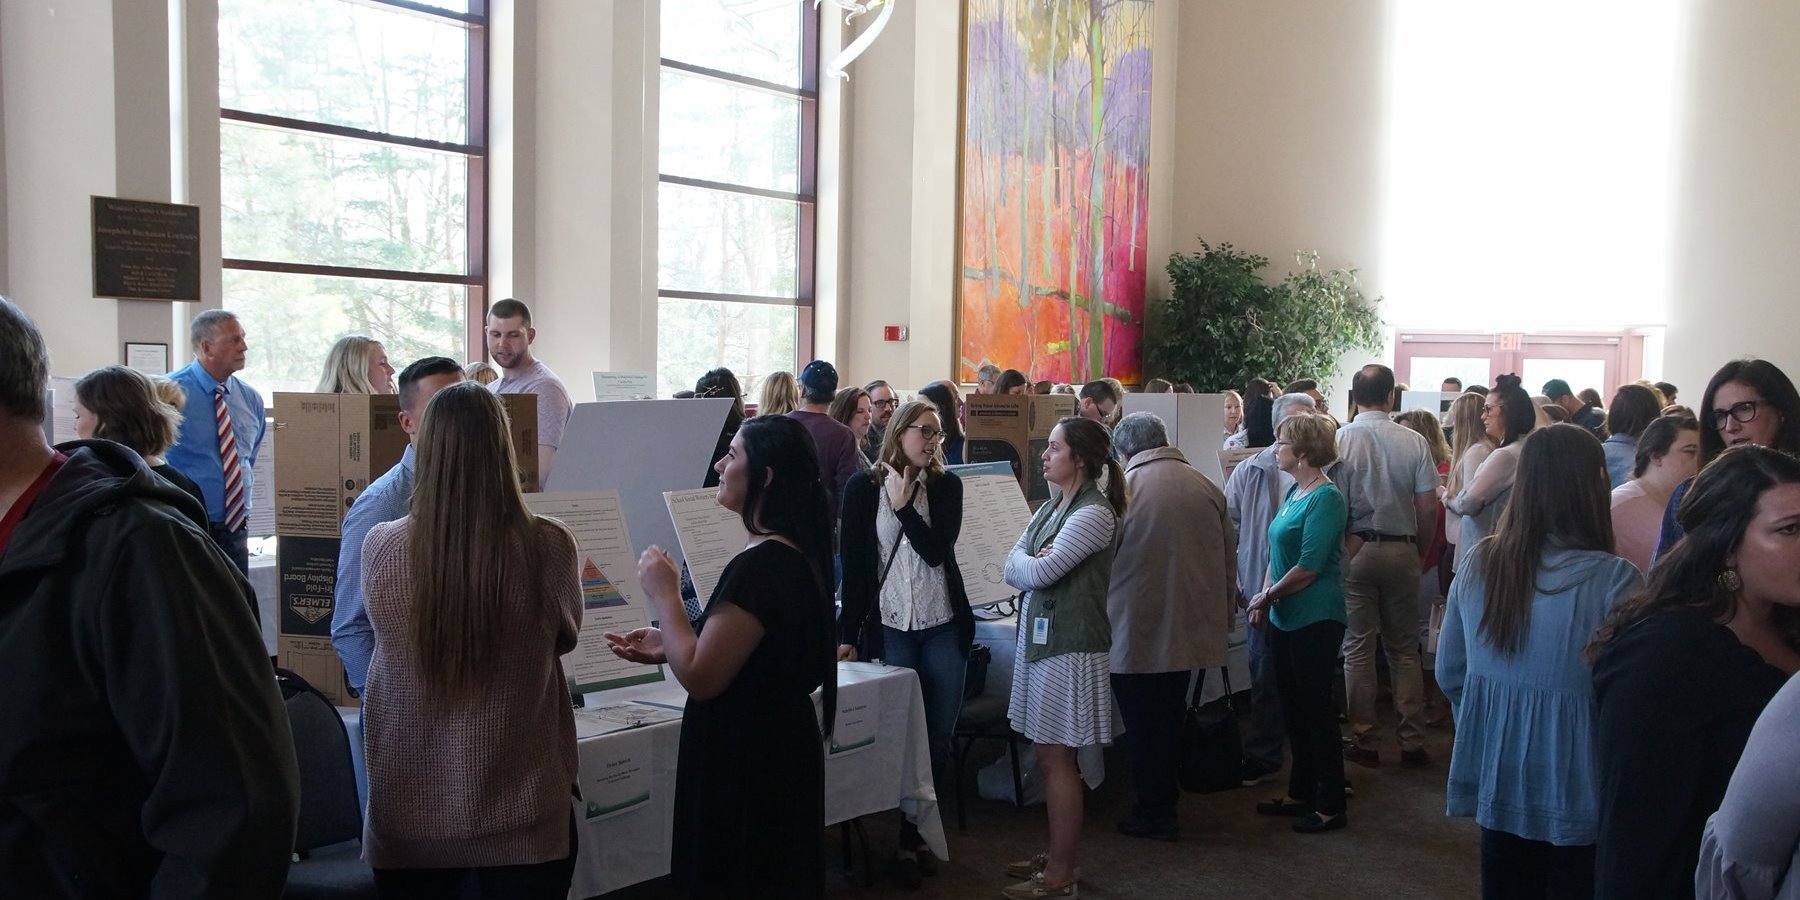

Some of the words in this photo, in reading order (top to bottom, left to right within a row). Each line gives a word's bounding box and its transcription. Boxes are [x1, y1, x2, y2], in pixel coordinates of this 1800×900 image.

[1500, 334, 1522, 350] EXIT
[284, 573, 306, 583] Board
[307, 574, 334, 584] Display
[306, 584, 333, 593] Tri-Fold
[293, 597, 331, 607] ELMER'S
